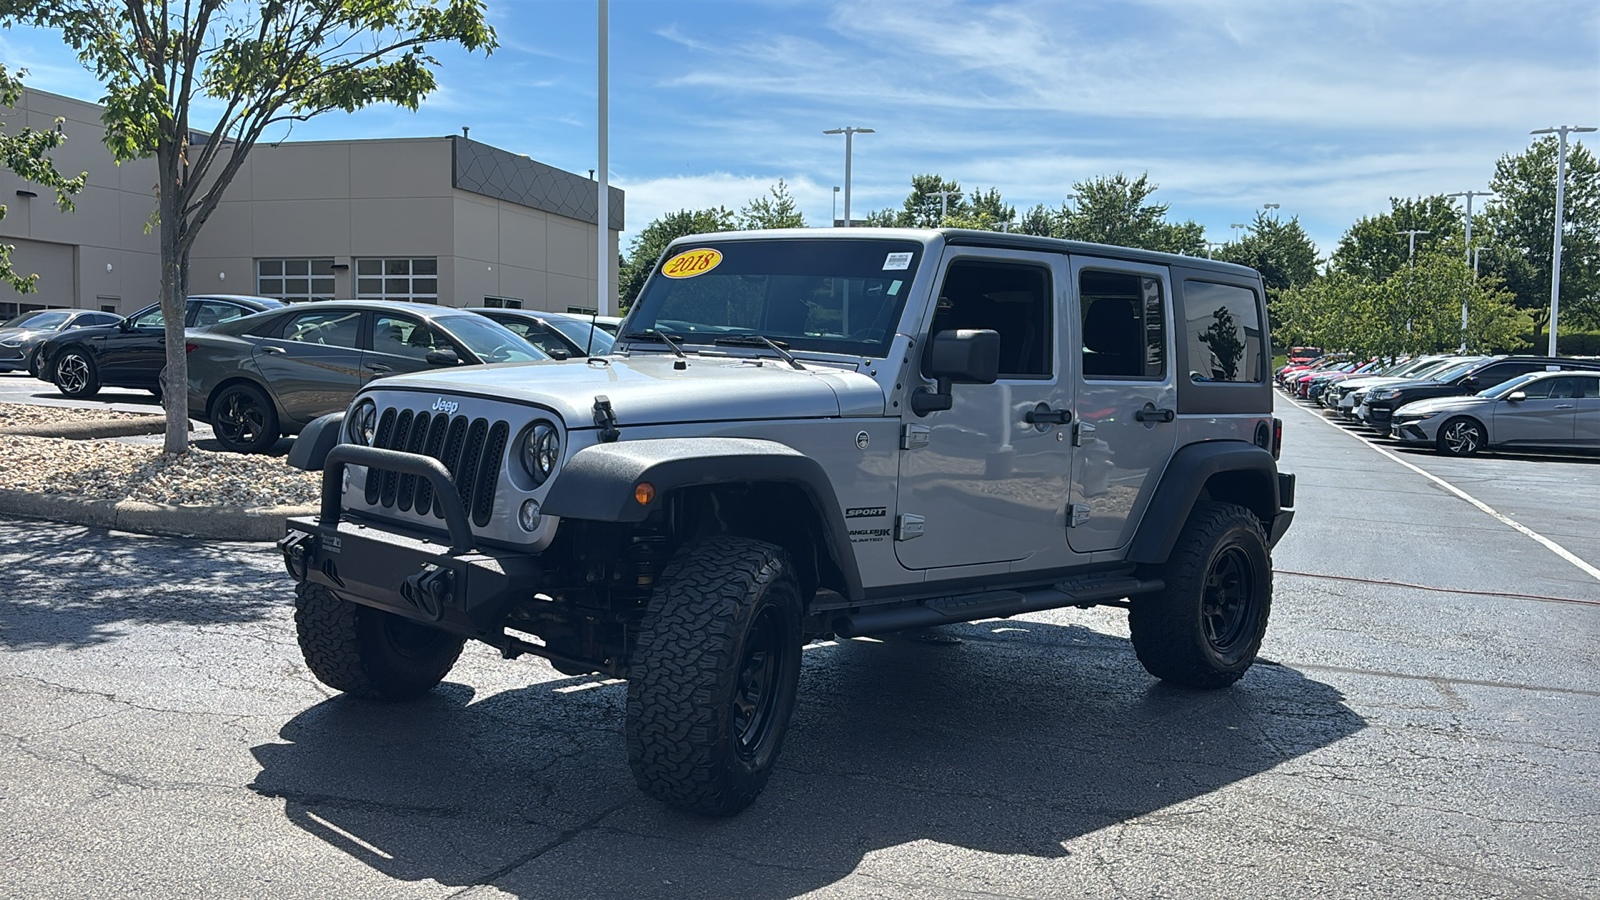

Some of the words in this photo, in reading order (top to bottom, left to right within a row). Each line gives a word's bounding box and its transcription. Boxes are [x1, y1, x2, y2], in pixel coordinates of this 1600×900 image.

[669, 253, 715, 274] 2018
[432, 397, 459, 415] Jeep
[846, 508, 886, 517] SPORT
